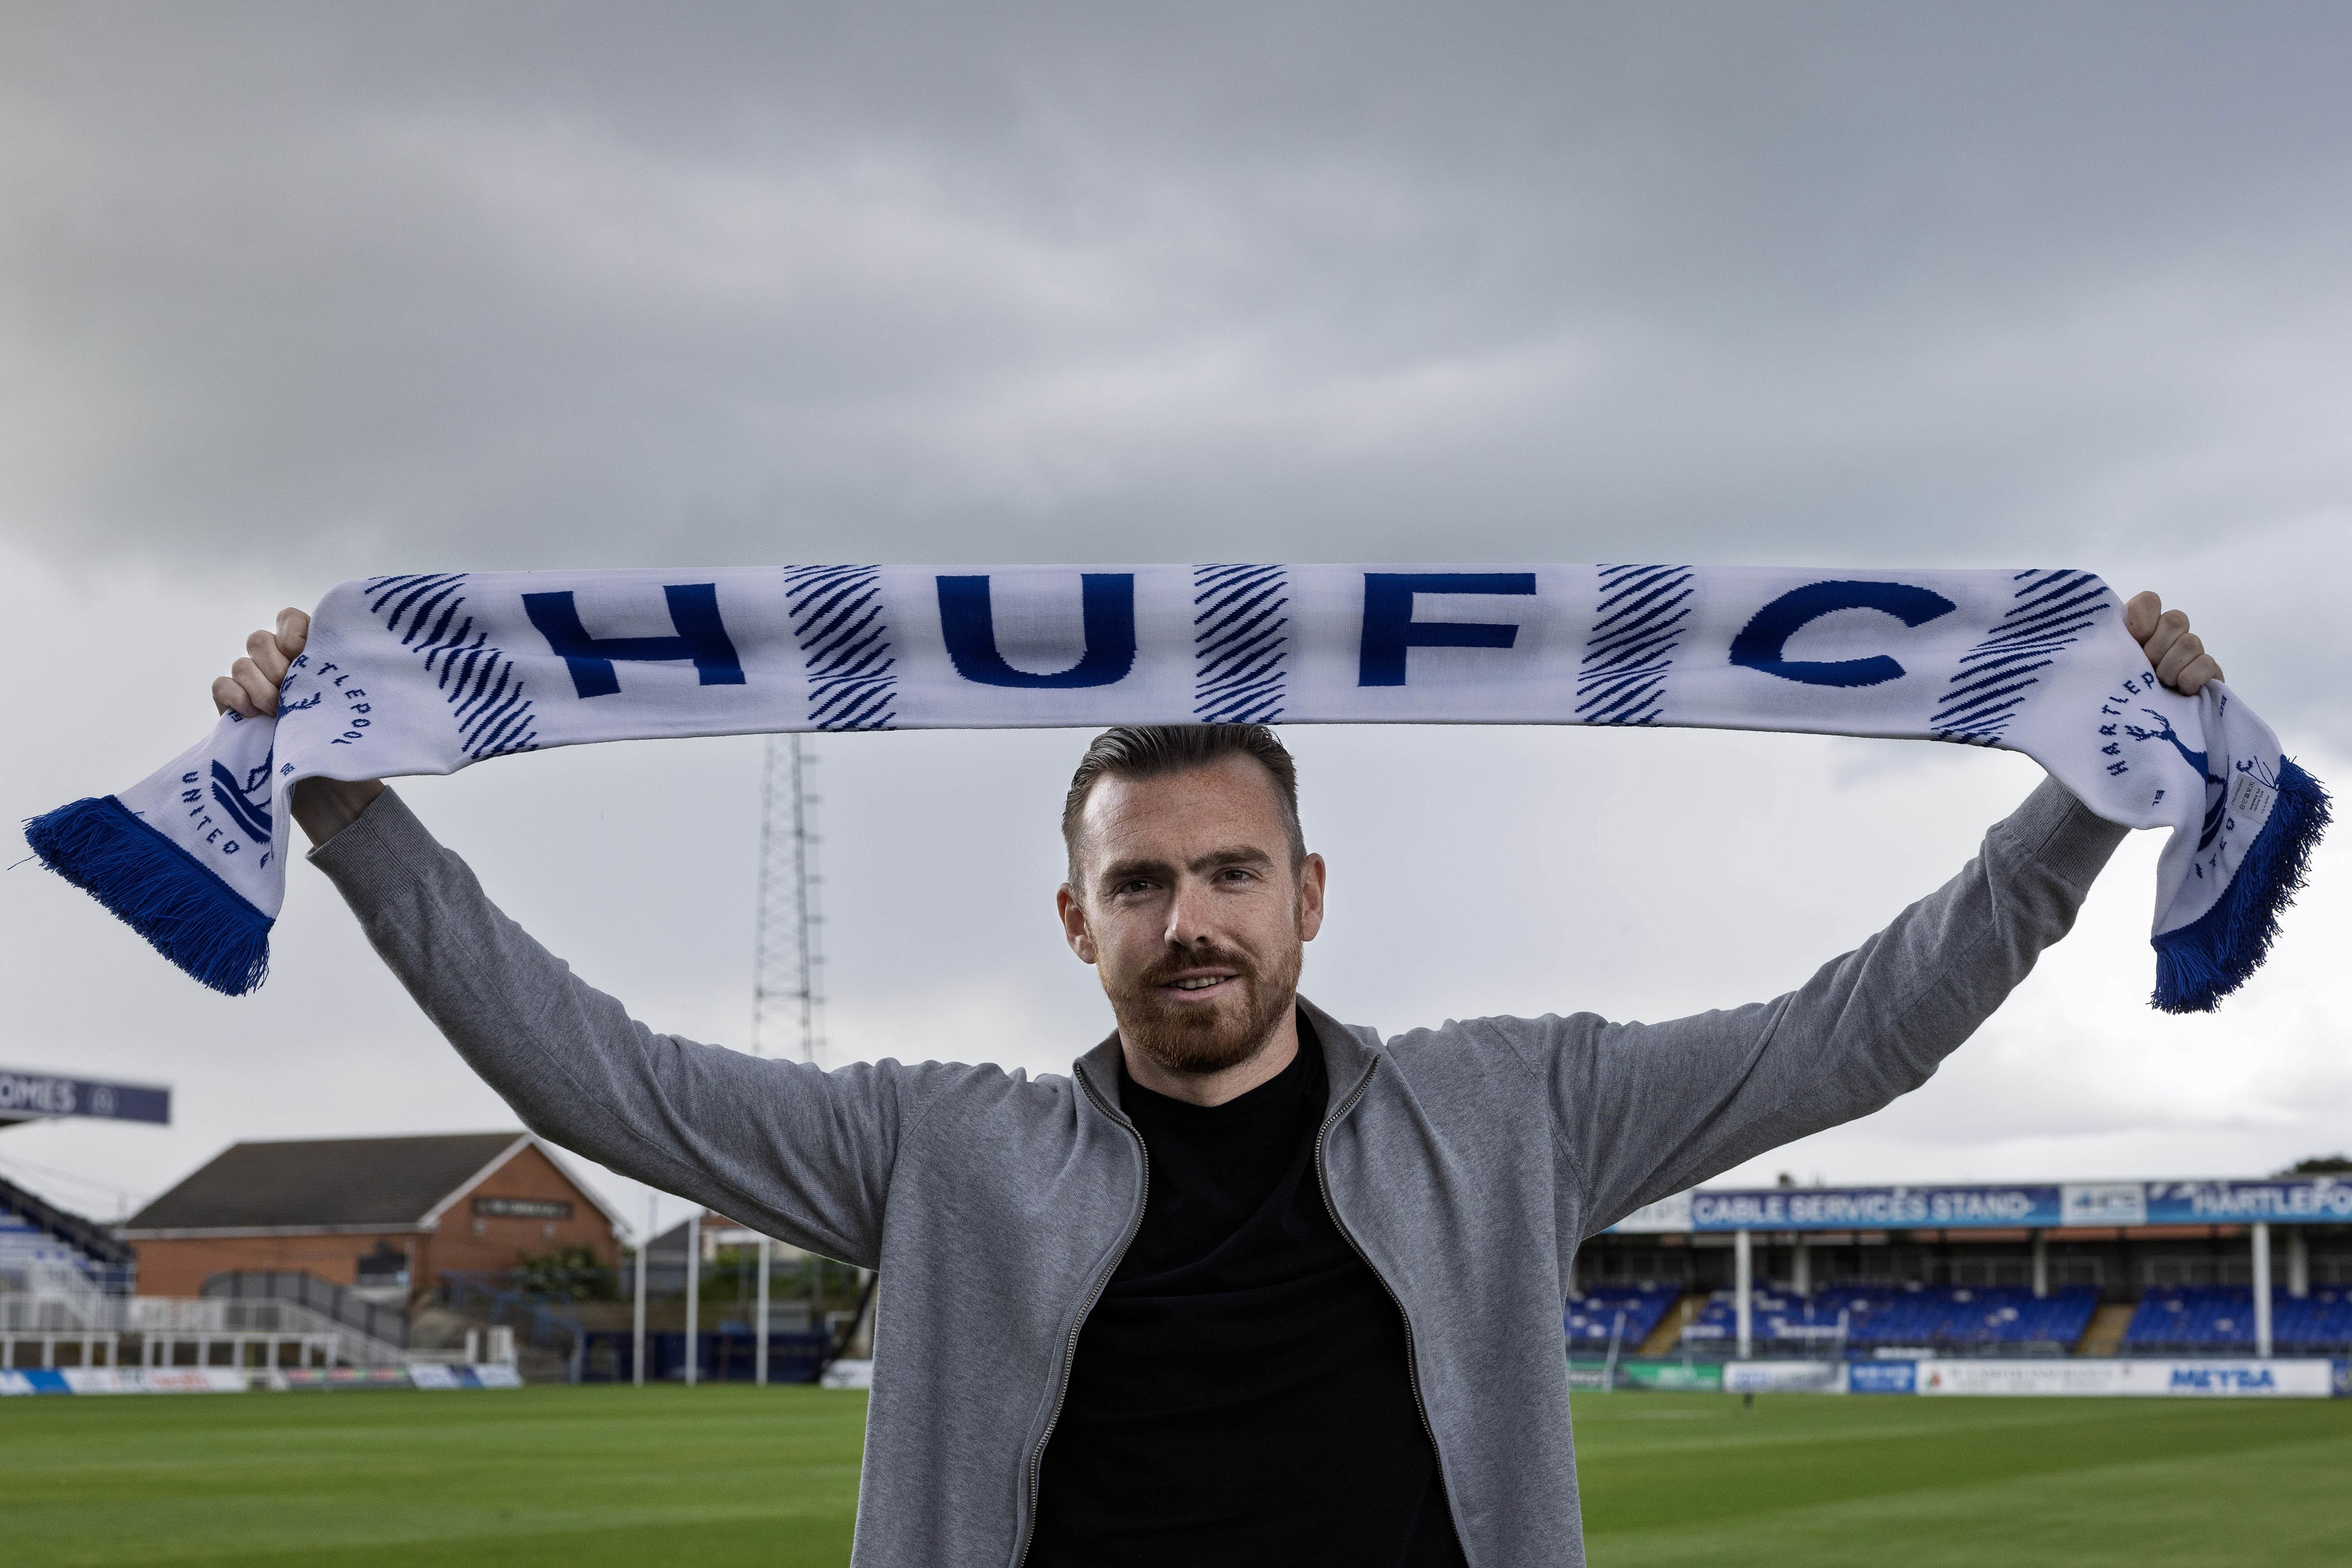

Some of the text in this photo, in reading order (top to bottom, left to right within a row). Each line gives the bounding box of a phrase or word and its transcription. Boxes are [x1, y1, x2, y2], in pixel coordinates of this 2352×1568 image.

[181, 771, 240, 855] UNITED
[1693, 1196, 1785, 1224] CABLE
[1789, 1193, 1928, 1222] SERVICES
[1930, 1192, 2029, 1221] STAND
